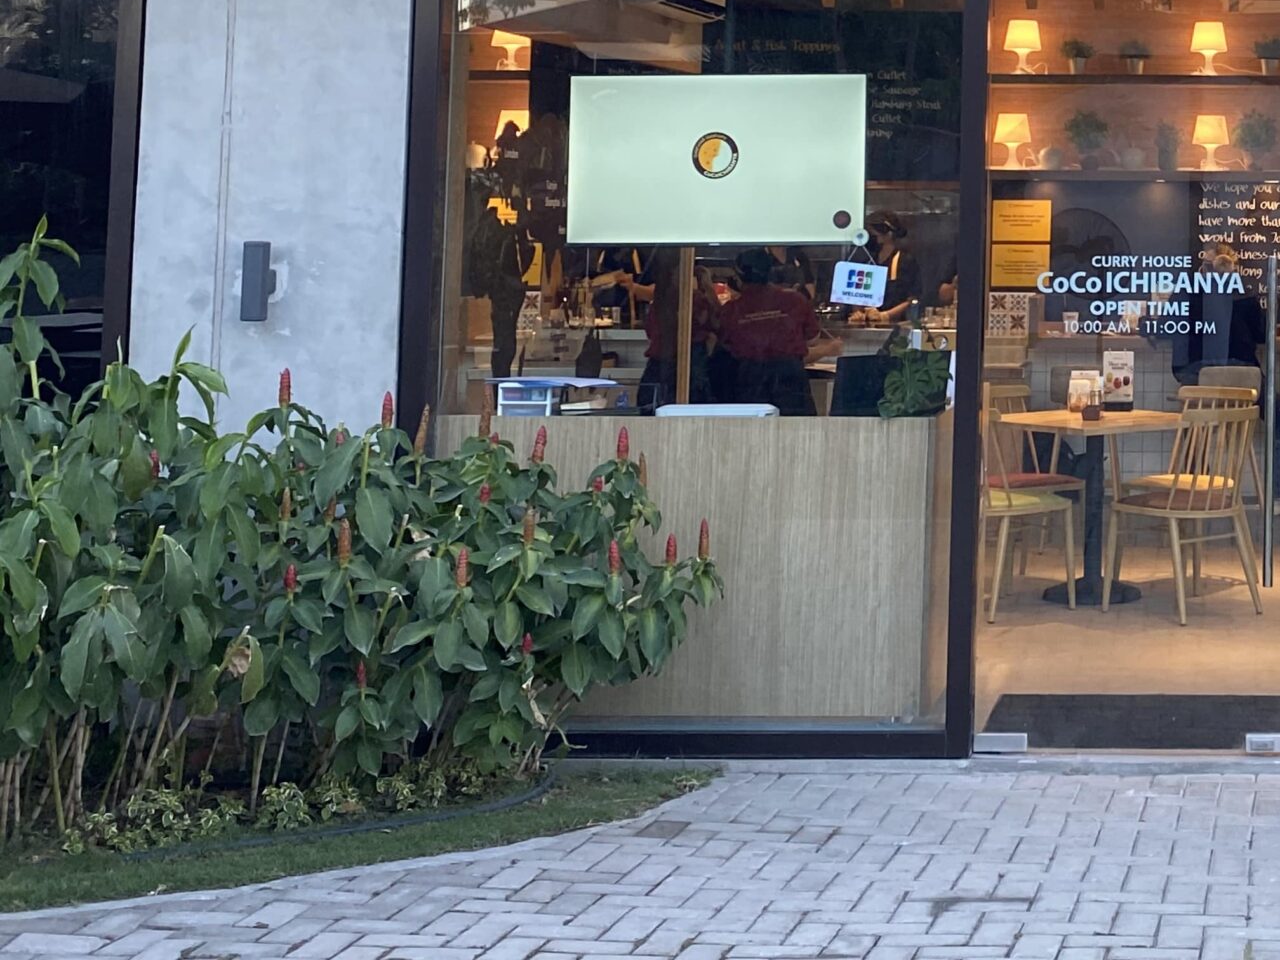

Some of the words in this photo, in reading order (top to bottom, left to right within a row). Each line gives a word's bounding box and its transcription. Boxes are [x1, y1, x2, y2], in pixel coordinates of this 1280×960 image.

[1200, 182, 1220, 193] We
[1224, 182, 1249, 195] hope
[1253, 184, 1272, 195] you
[1199, 198, 1231, 210] dishes
[1235, 198, 1256, 210] and
[1260, 202, 1280, 210] our
[1198, 215, 1223, 227] have
[1227, 216, 1256, 227] more
[1199, 231, 1233, 244] world
[1240, 231, 1266, 244] from
[1091, 255, 1139, 268] CURRY
[1142, 256, 1192, 268] HOUSE
[1090, 300, 1141, 316] OPEN
[1147, 301, 1190, 316] TIME
[1064, 320, 1102, 334] 10:00
[1105, 320, 1131, 334] AM
[1195, 321, 1216, 335] PM
